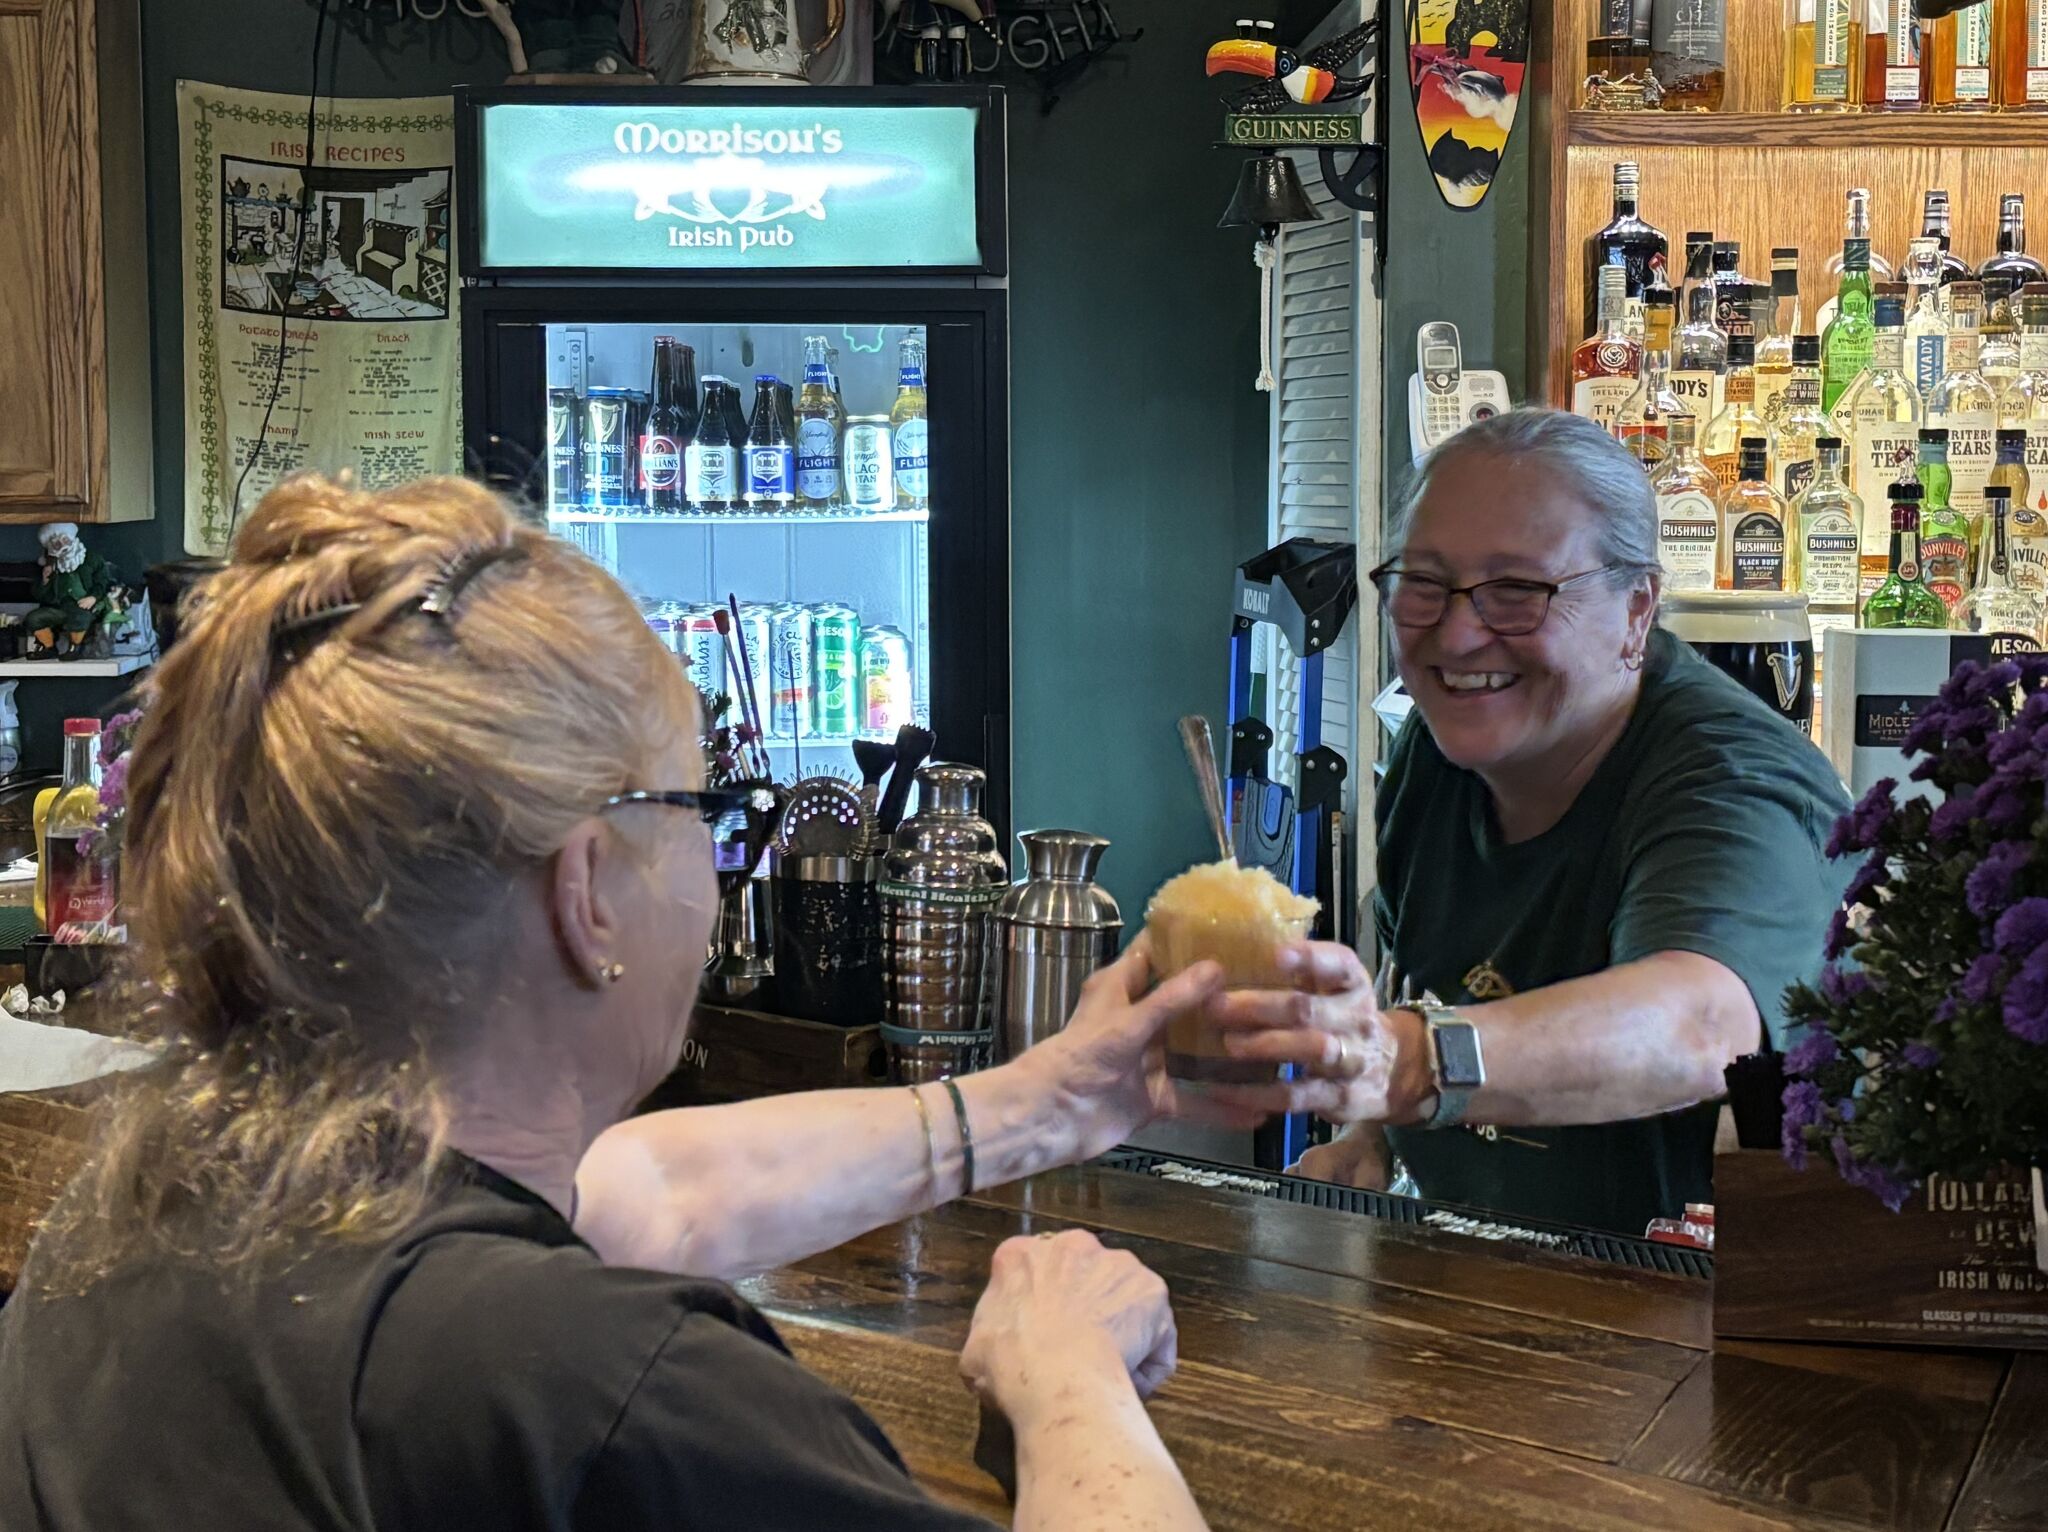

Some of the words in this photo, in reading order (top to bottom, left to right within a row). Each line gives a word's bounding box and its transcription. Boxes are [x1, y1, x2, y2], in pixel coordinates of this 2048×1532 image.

[1234, 118, 1352, 139] GUINNESS
[614, 121, 844, 155] Morrison's
[270, 142, 314, 160] IRIS
[326, 145, 405, 162] RECIPES
[668, 226, 733, 247] Irish
[740, 224, 794, 253] Pub
[1921, 338, 1933, 399] IMAVADY
[1951, 429, 1992, 440] RITERS
[583, 441, 625, 455] GNNESS
[1872, 439, 1919, 451] WRITER
[1950, 441, 1992, 455] EARS
[901, 459, 928, 468] FLIG
[1662, 524, 1716, 537] BUSHMILLS
[1734, 541, 1783, 553] BUSHMILLS
[1809, 538, 1856, 549] BUSHMILLS
[1243, 587, 1270, 615] KOBALT
[1990, 638, 2040, 654] MESO
[1869, 713, 1920, 730] MIDLE
[881, 884, 928, 900] Mental
[930, 890, 989, 903] Health
[1927, 1171, 2034, 1213] TULLAM
[1938, 1270, 1989, 1289] IRISH
[1922, 1310, 1962, 1322] GLASSES
